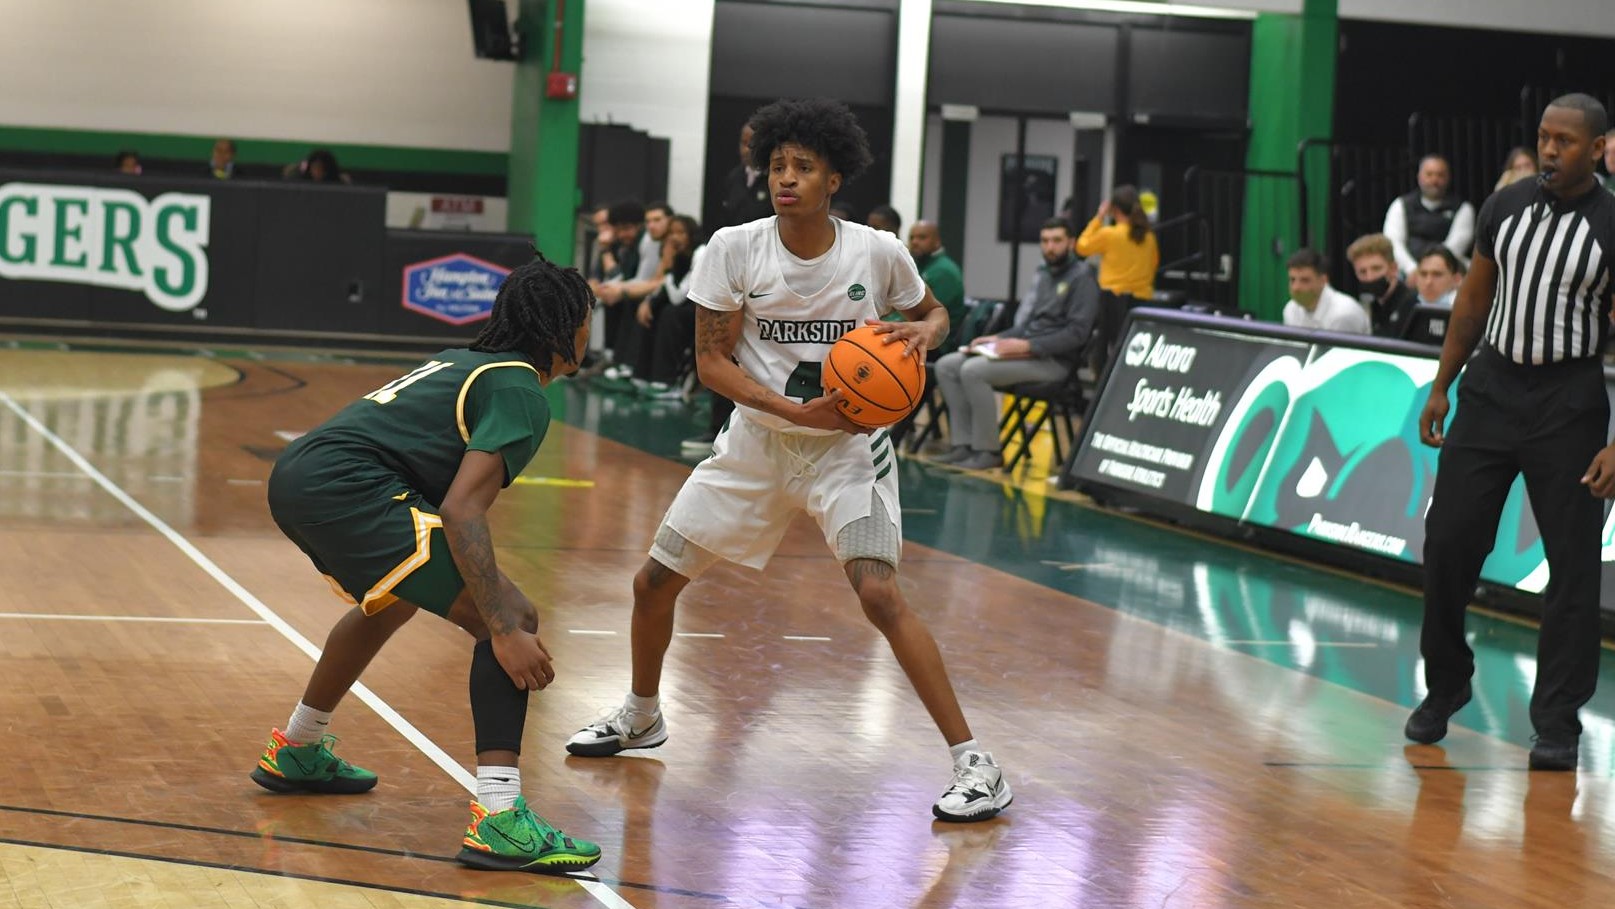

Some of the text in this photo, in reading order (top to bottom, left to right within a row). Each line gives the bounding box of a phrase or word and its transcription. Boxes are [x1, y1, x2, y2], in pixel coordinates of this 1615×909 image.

[0, 194, 198, 297] GERS
[1144, 334, 1197, 373] Aurora
[784, 360, 824, 405] 4
[1127, 378, 1221, 426] Sports Health
